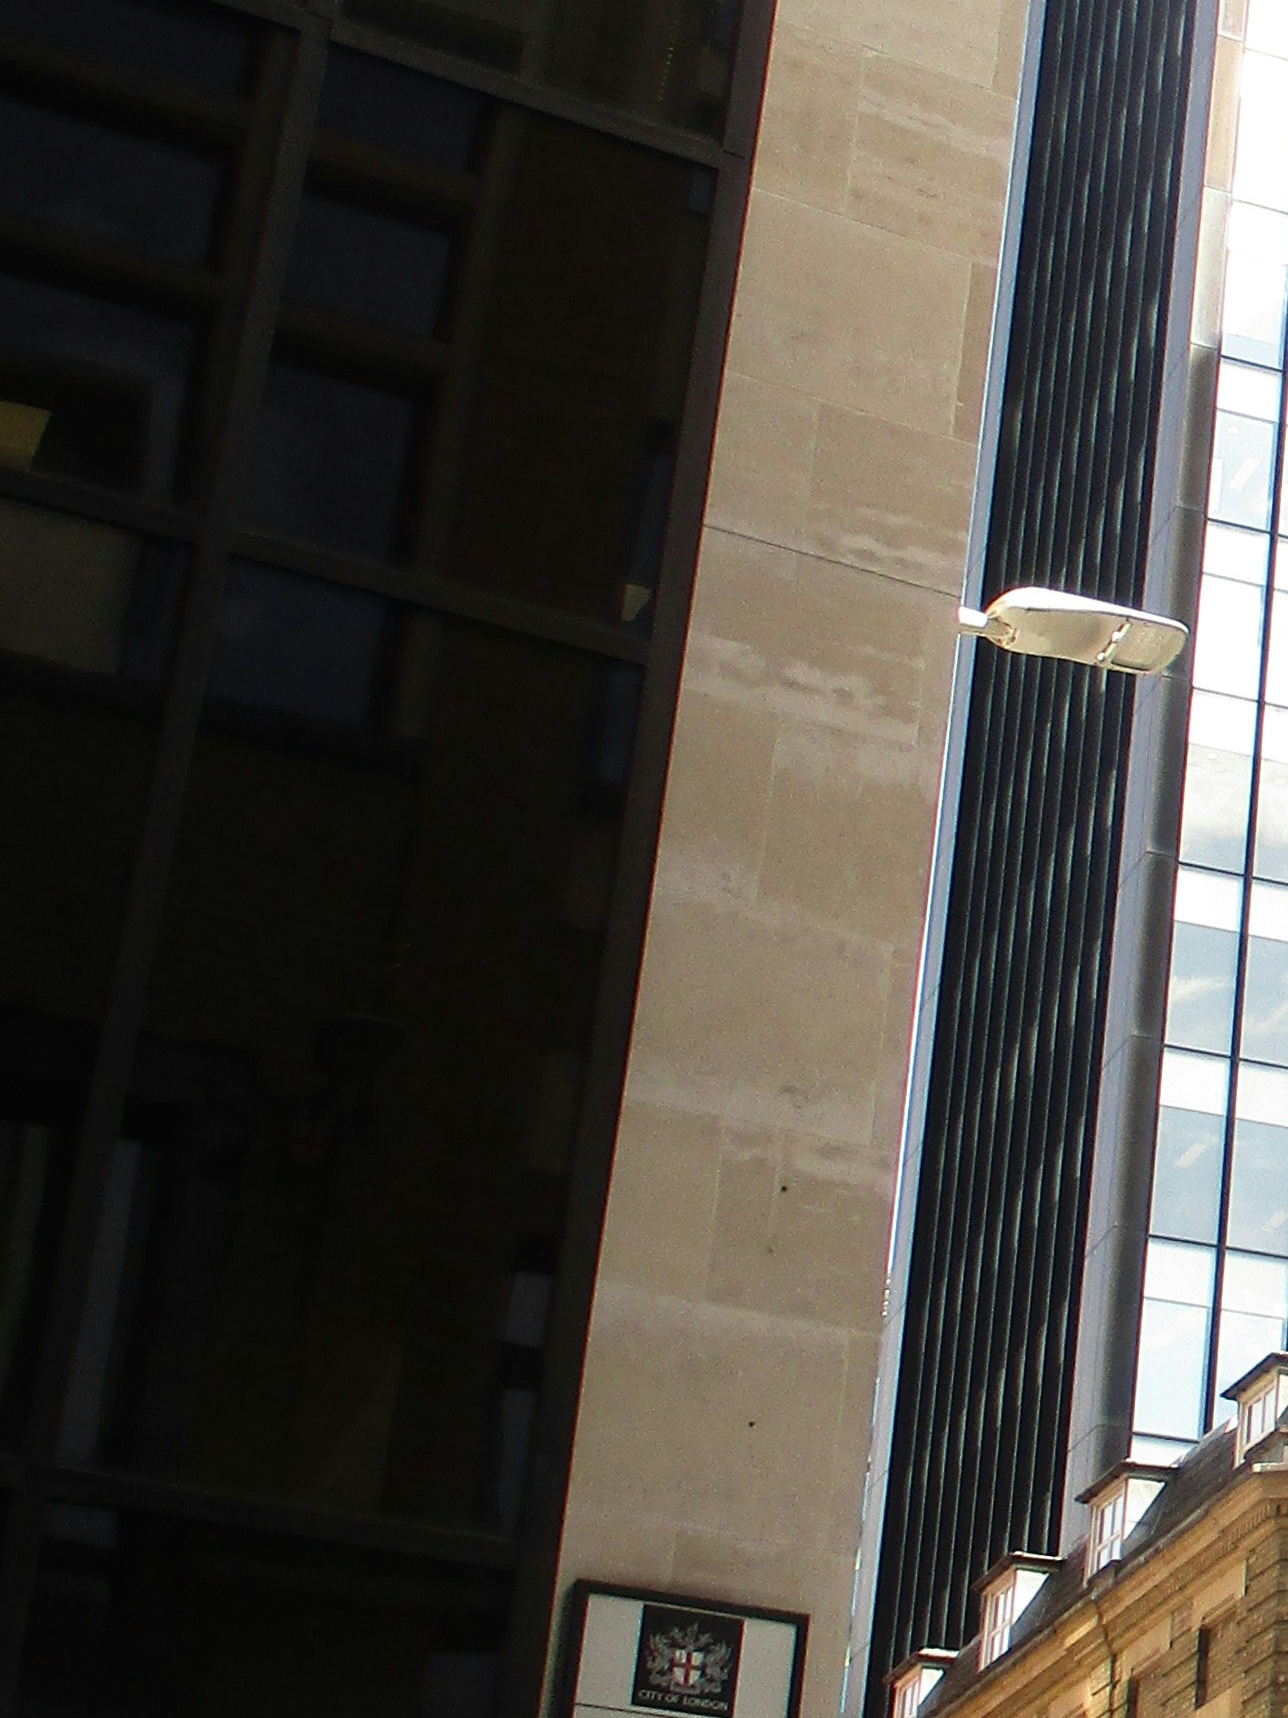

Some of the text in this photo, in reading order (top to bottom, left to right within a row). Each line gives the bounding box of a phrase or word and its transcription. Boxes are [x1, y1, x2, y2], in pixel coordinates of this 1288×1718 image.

[638, 1689, 729, 1711] CITY OF LONDON
